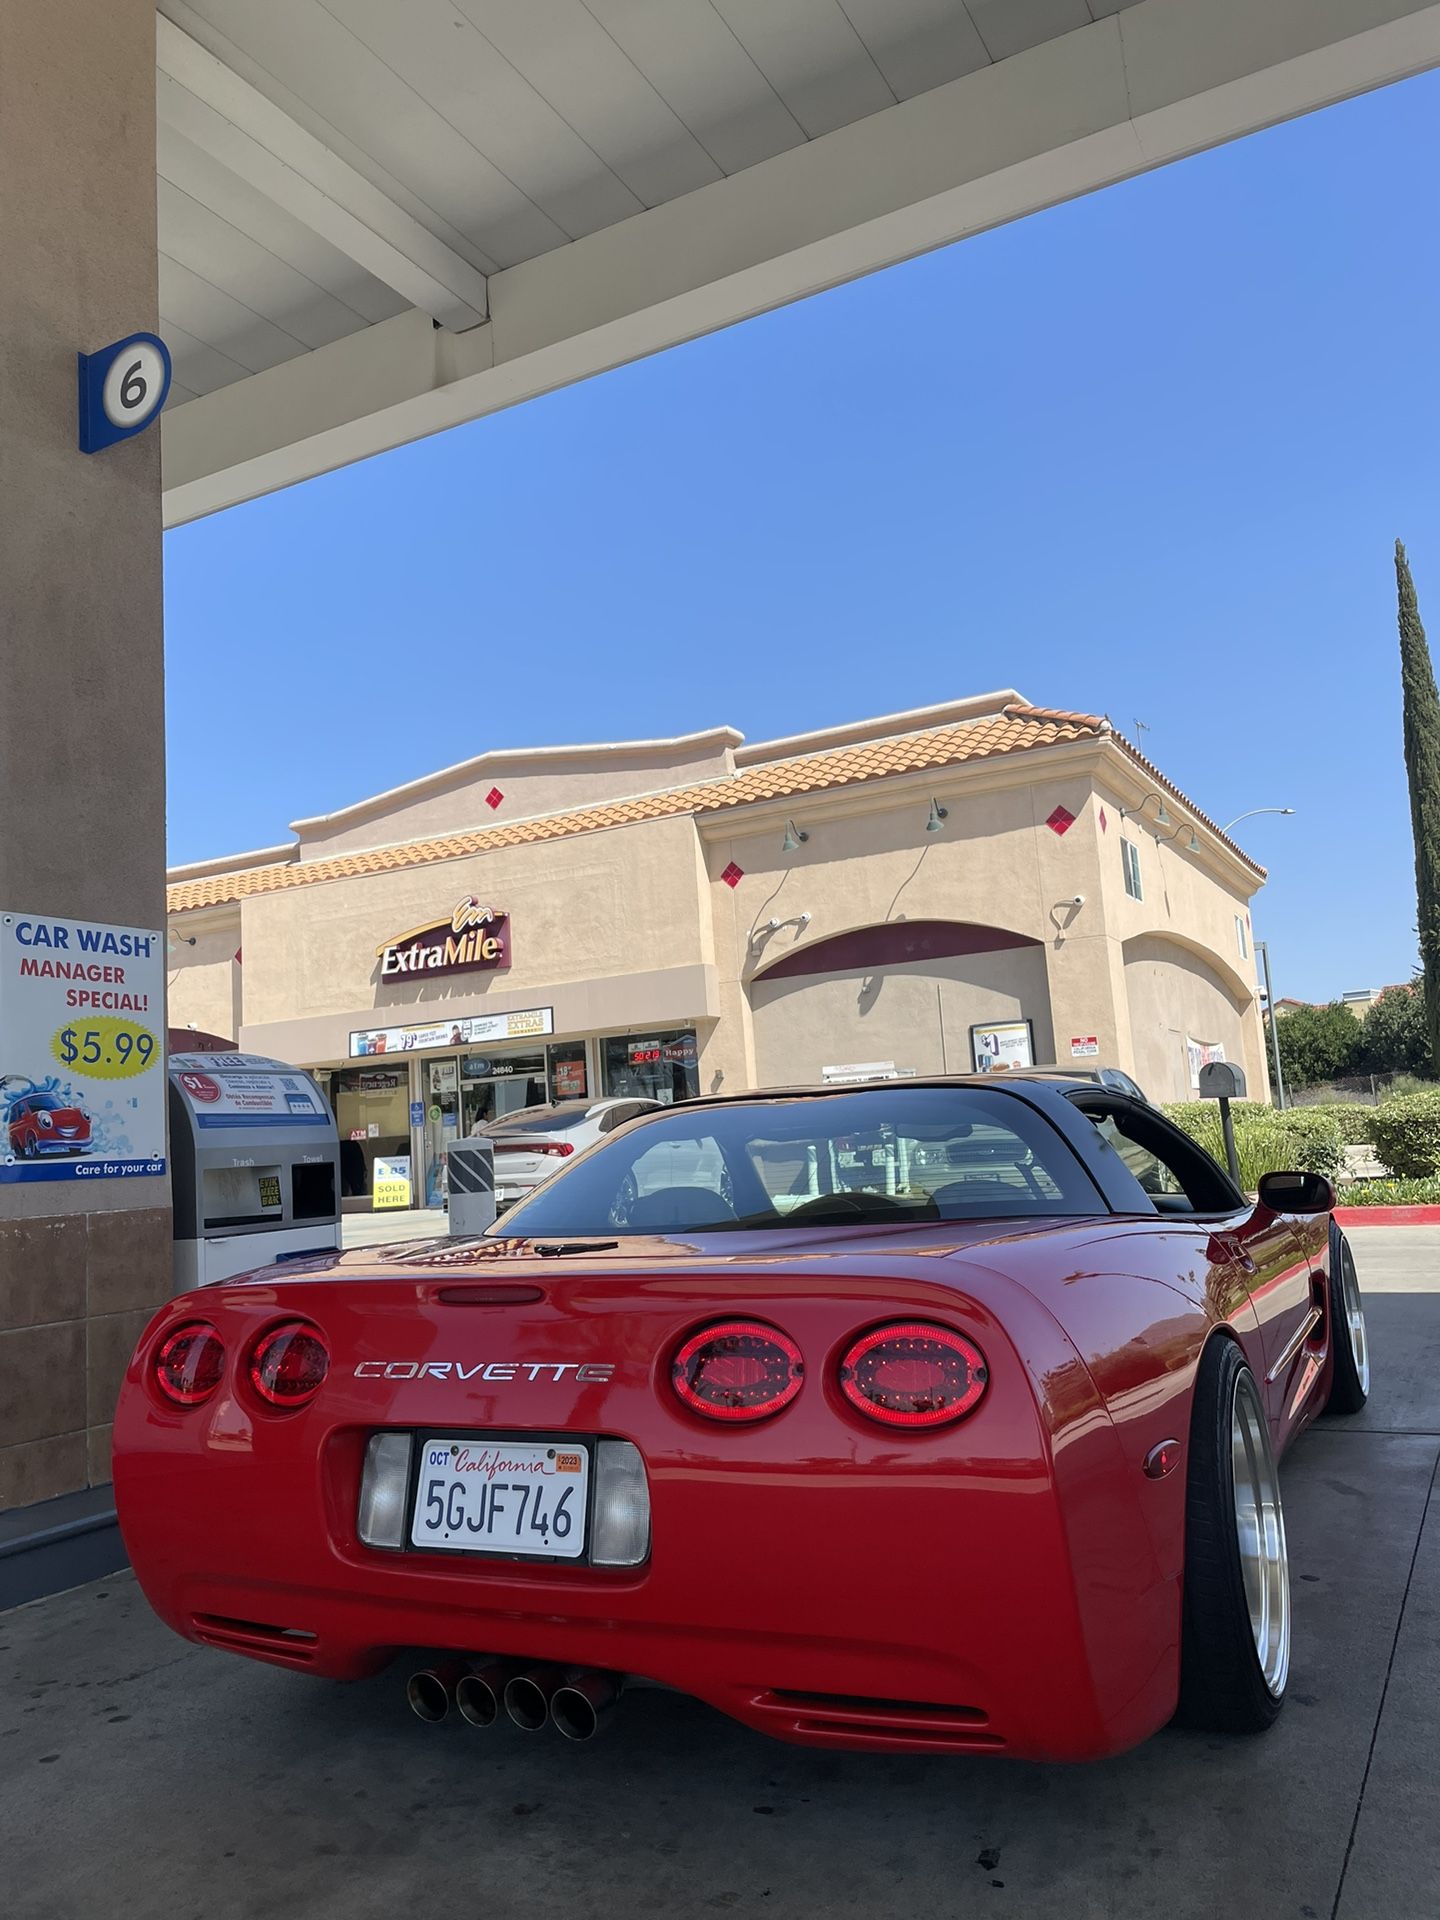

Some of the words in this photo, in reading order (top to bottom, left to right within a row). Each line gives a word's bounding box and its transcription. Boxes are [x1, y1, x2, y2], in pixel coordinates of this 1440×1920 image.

[120, 360, 147, 409] 6
[15, 922, 69, 949] CAR
[77, 929, 151, 958] WASH
[381, 929, 499, 975] ExtraMile
[20, 958, 125, 984] MANAGER
[66, 989, 149, 1011] SPECIAL!
[507, 1011, 544, 1021] EXTRAMILE
[507, 1018, 545, 1030] EXTRAS
[60, 1028, 154, 1066] $5.99
[665, 1048, 694, 1057] Happy
[76, 1165, 100, 1175] Care
[103, 1163, 119, 1174] for
[121, 1164, 144, 1175] your
[232, 1158, 255, 1167] Trash
[302, 1155, 323, 1163] Towel
[378, 1184, 405, 1192] SOLD
[353, 1361, 616, 1382] CORVETTE
[429, 1451, 450, 1466] OCT
[454, 1449, 556, 1481] California
[561, 1456, 578, 1465] 2023
[425, 1480, 575, 1538] 5GJF746
